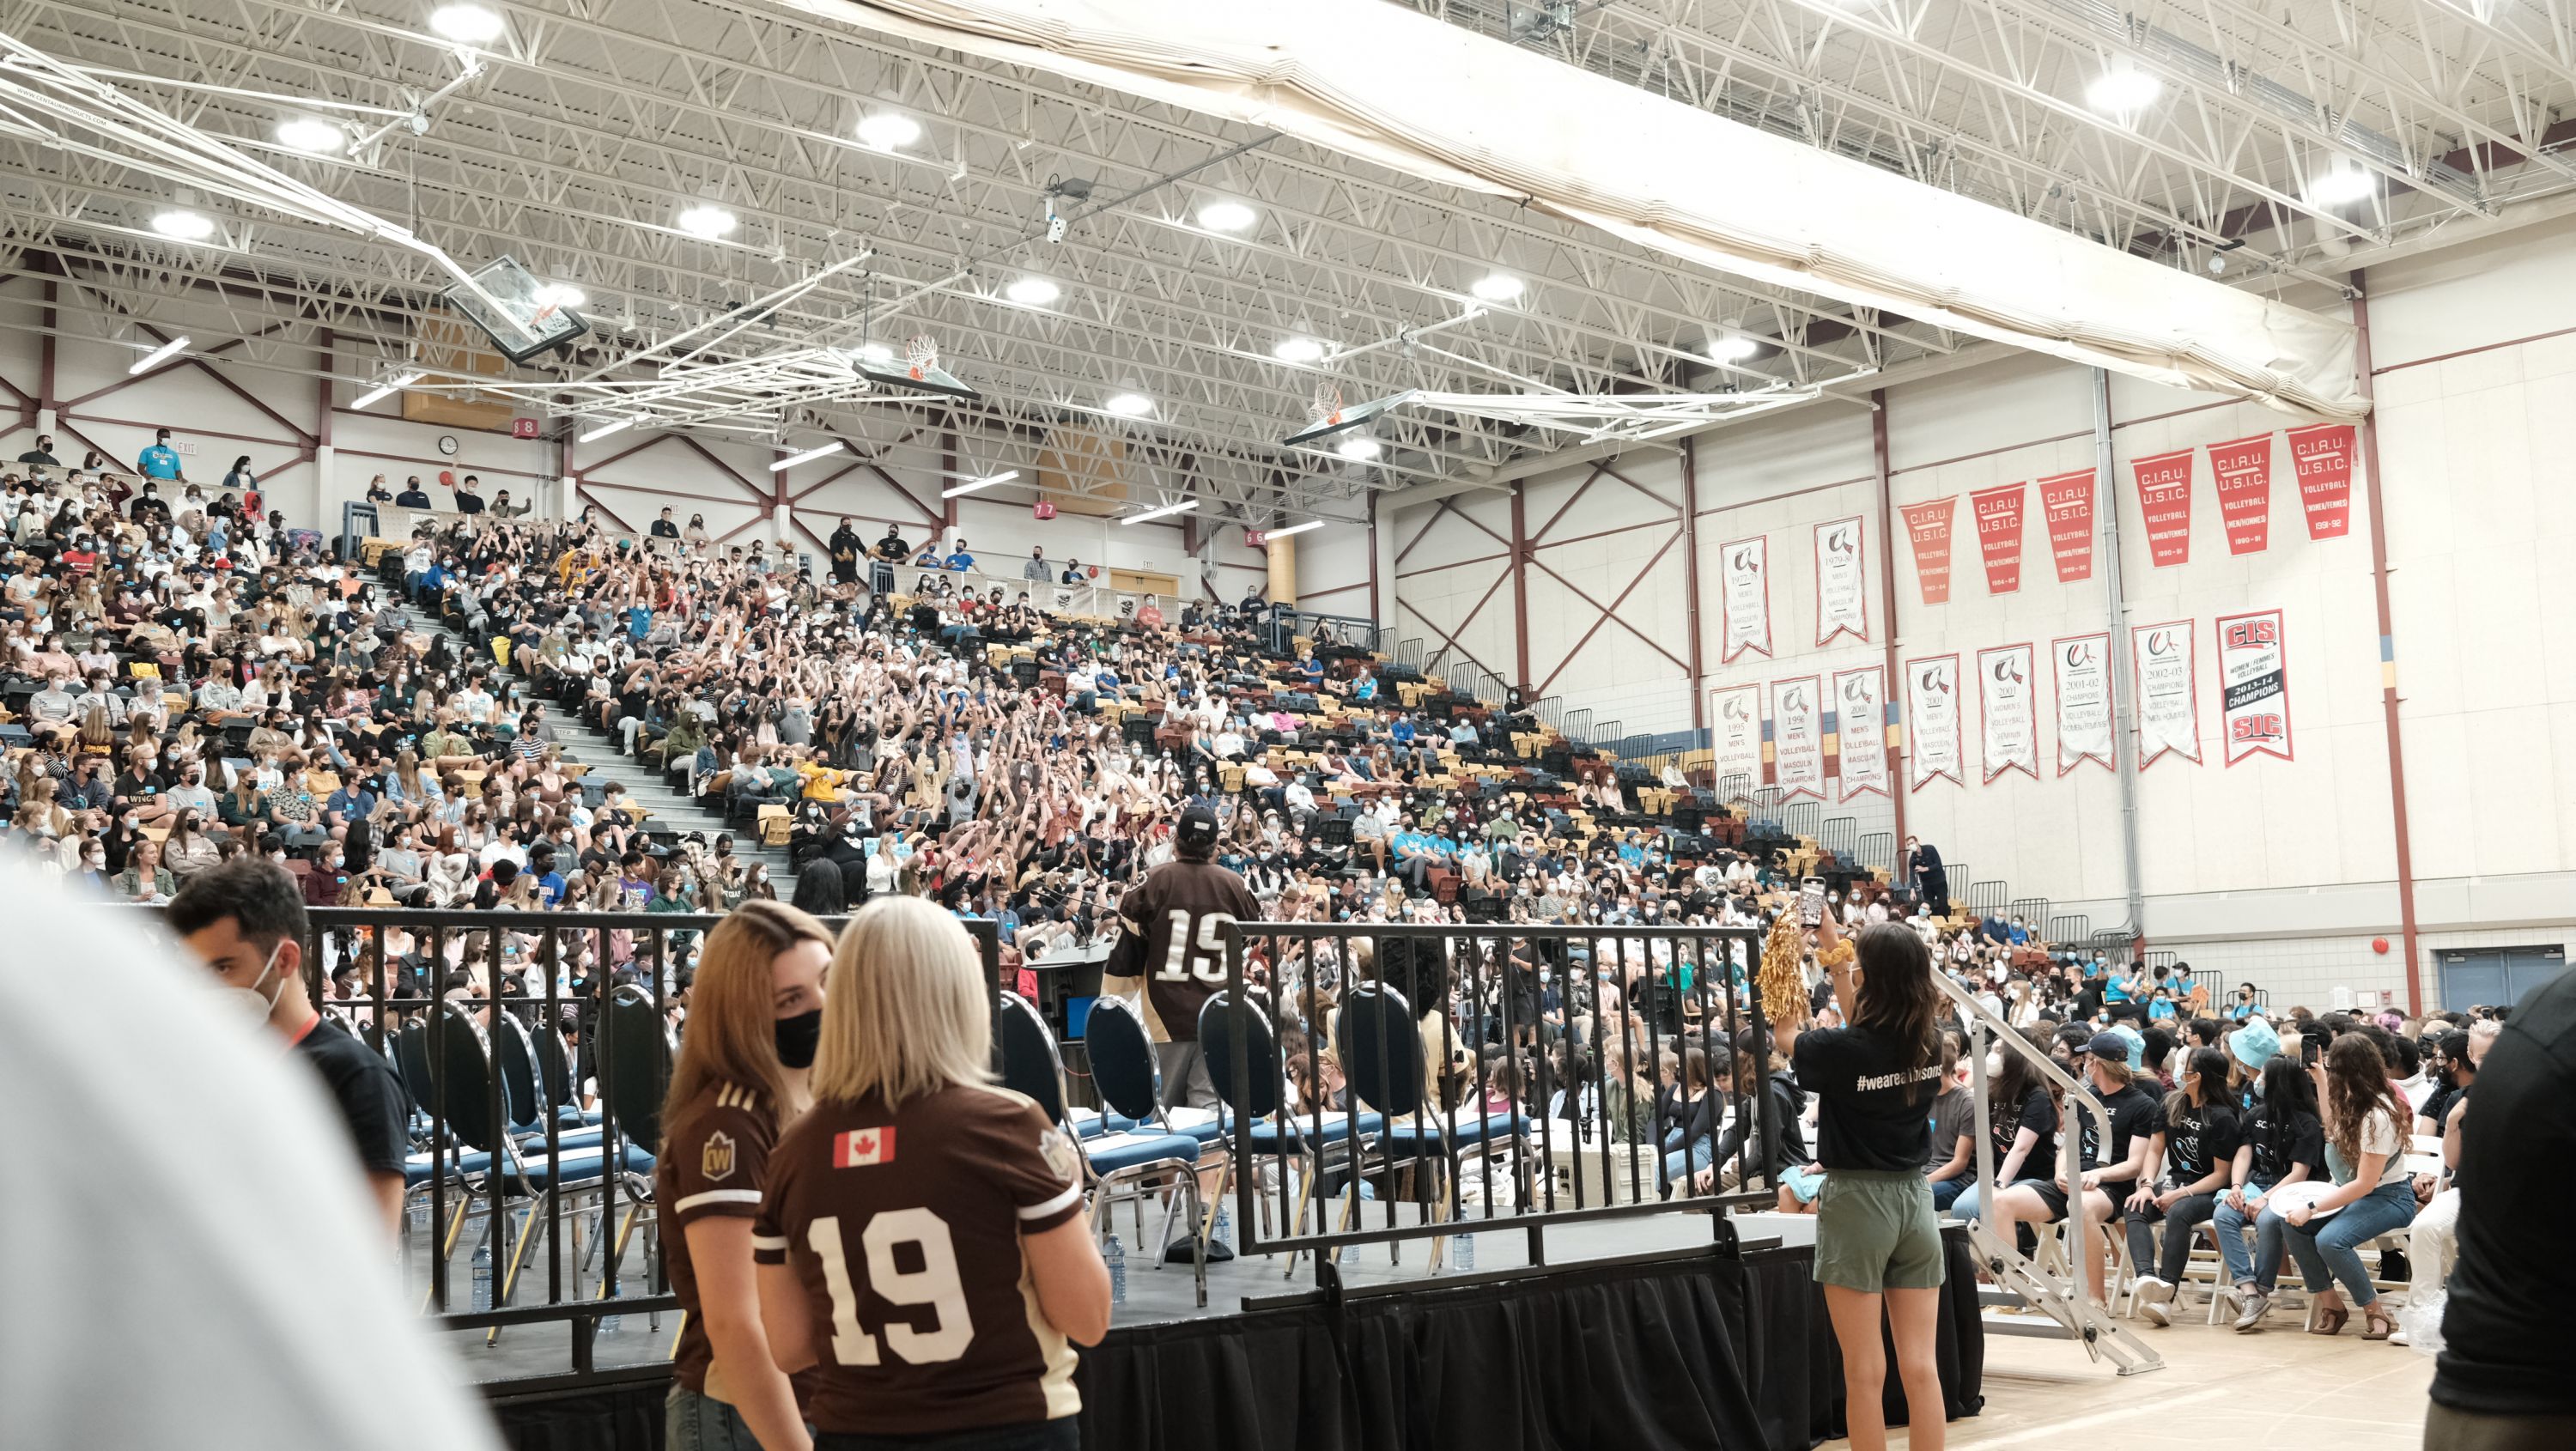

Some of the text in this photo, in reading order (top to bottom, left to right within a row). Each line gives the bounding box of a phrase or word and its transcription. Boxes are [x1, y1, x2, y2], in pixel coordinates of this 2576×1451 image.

[16, 88, 107, 126] WWW.CENTAURPRODUCTS.COM
[525, 421, 533, 433] 8
[178, 442, 196, 453] EXIT
[2299, 458, 2348, 476] U.S.I.C.
[2220, 473, 2267, 491] U.S.I.C.
[2304, 479, 2348, 495] VOLLEYBALL
[2143, 488, 2188, 505] U.S.I.C.
[1047, 504, 1054, 514] 7
[2224, 496, 2266, 511] VOLLEYBALL
[2049, 507, 2091, 523] U.S.I.C.
[2148, 509, 2187, 524] VOLLEYBALL
[1980, 517, 2021, 533] U.S.I.C.
[2315, 519, 2342, 531] 1991-92
[1247, 532, 1252, 543] 6
[1256, 531, 1263, 542] 6
[1912, 527, 1949, 543] U.S.I.C.
[2052, 529, 2090, 543] VOLLEYBALL
[1984, 538, 2019, 552] VOLLEYBALL
[1917, 549, 1949, 561] VOLLEYBALL
[1143, 561, 1154, 570] EXIT
[2226, 620, 2276, 645] CIS
[2230, 661, 2250, 674] WOMEN
[2253, 652, 2275, 666] FEMMES
[2147, 666, 2183, 680] 2002-03
[2237, 663, 2269, 679] VOLLEYBALL
[2066, 679, 2099, 690] 2001-02
[2234, 676, 2273, 695] 2013-14
[1999, 686, 2017, 696] 2001
[2066, 690, 2099, 702] CHAMPIONS
[2228, 683, 2279, 708] CHAMPIONS
[1925, 695, 1944, 707] 2001
[1787, 715, 1805, 726] 1996
[2233, 713, 2282, 738] SIC
[1728, 723, 1745, 733] 1995
[1787, 731, 1807, 741] MEN'S
[1728, 739, 1746, 748] MEN'S
[1779, 744, 1817, 756] VOLLEYBALL
[1719, 752, 1756, 763] VOLLEYBALL
[1724, 766, 1753, 775] MASCULIN
[1783, 759, 1813, 770] MASCULIN
[1782, 774, 1816, 785] CHAMPIONS
[1845, 773, 1883, 783] CHAMPIONS
[807, 1206, 975, 1366] 19
